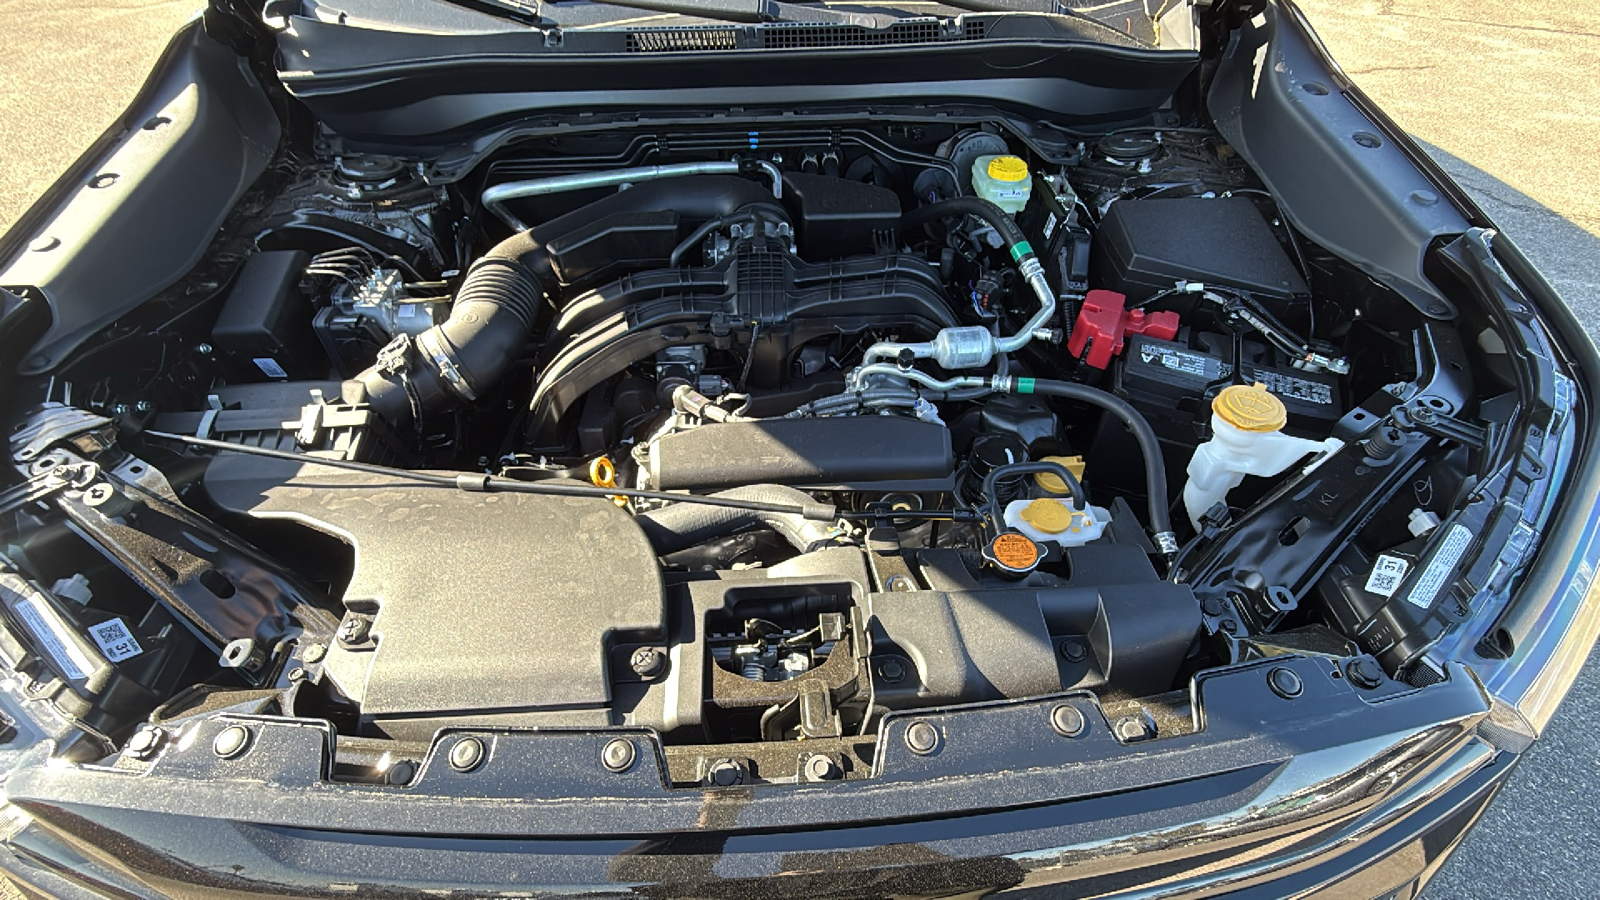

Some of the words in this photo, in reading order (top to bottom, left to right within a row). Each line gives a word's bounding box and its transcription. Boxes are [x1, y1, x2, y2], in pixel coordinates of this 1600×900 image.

[1319, 493, 1339, 506] KL
[1384, 560, 1398, 571] 31
[115, 643, 131, 655] 31
